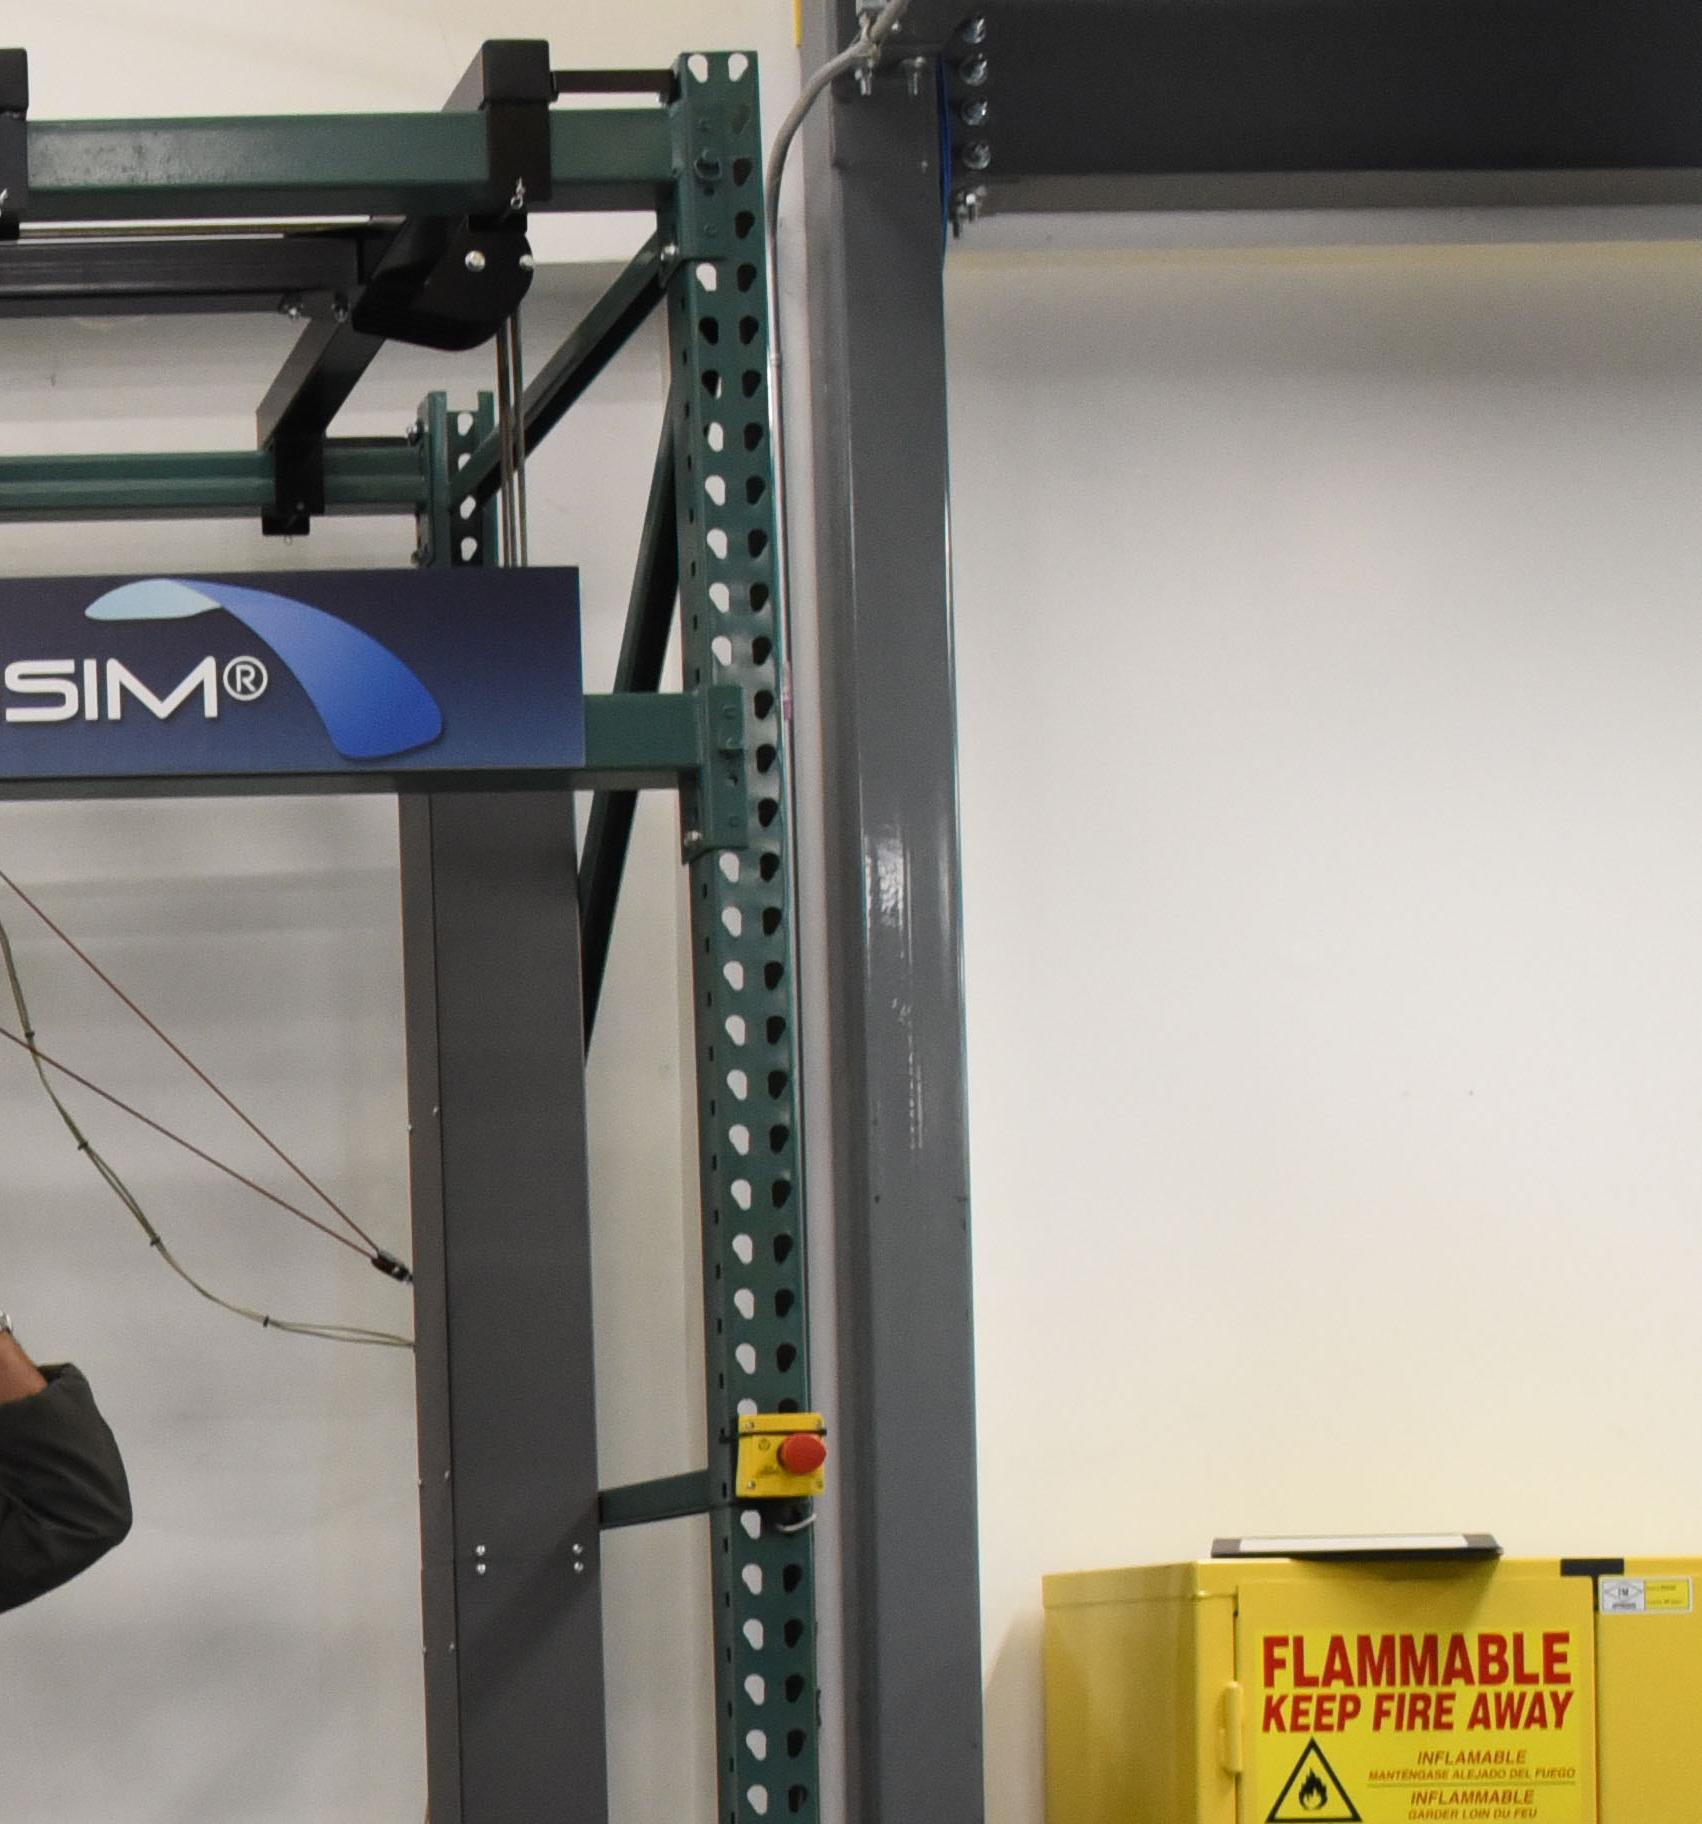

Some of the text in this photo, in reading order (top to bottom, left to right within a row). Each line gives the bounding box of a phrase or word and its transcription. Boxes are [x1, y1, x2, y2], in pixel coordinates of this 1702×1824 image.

[1262, 1631, 1572, 1688] FLAMMABLE
[1262, 1690, 1574, 1733] KEEP FIRE AWAY
[1417, 1750, 1527, 1766] INFLAMABLE
[1452, 1768, 1506, 1780] ALEJADO
[1509, 1768, 1531, 1779] DEL
[1535, 1767, 1576, 1779] FUEGO
[1411, 1789, 1535, 1806] INFLAMMABLE
[1408, 1807, 1537, 1820] GARDER LOIN DU FEU
